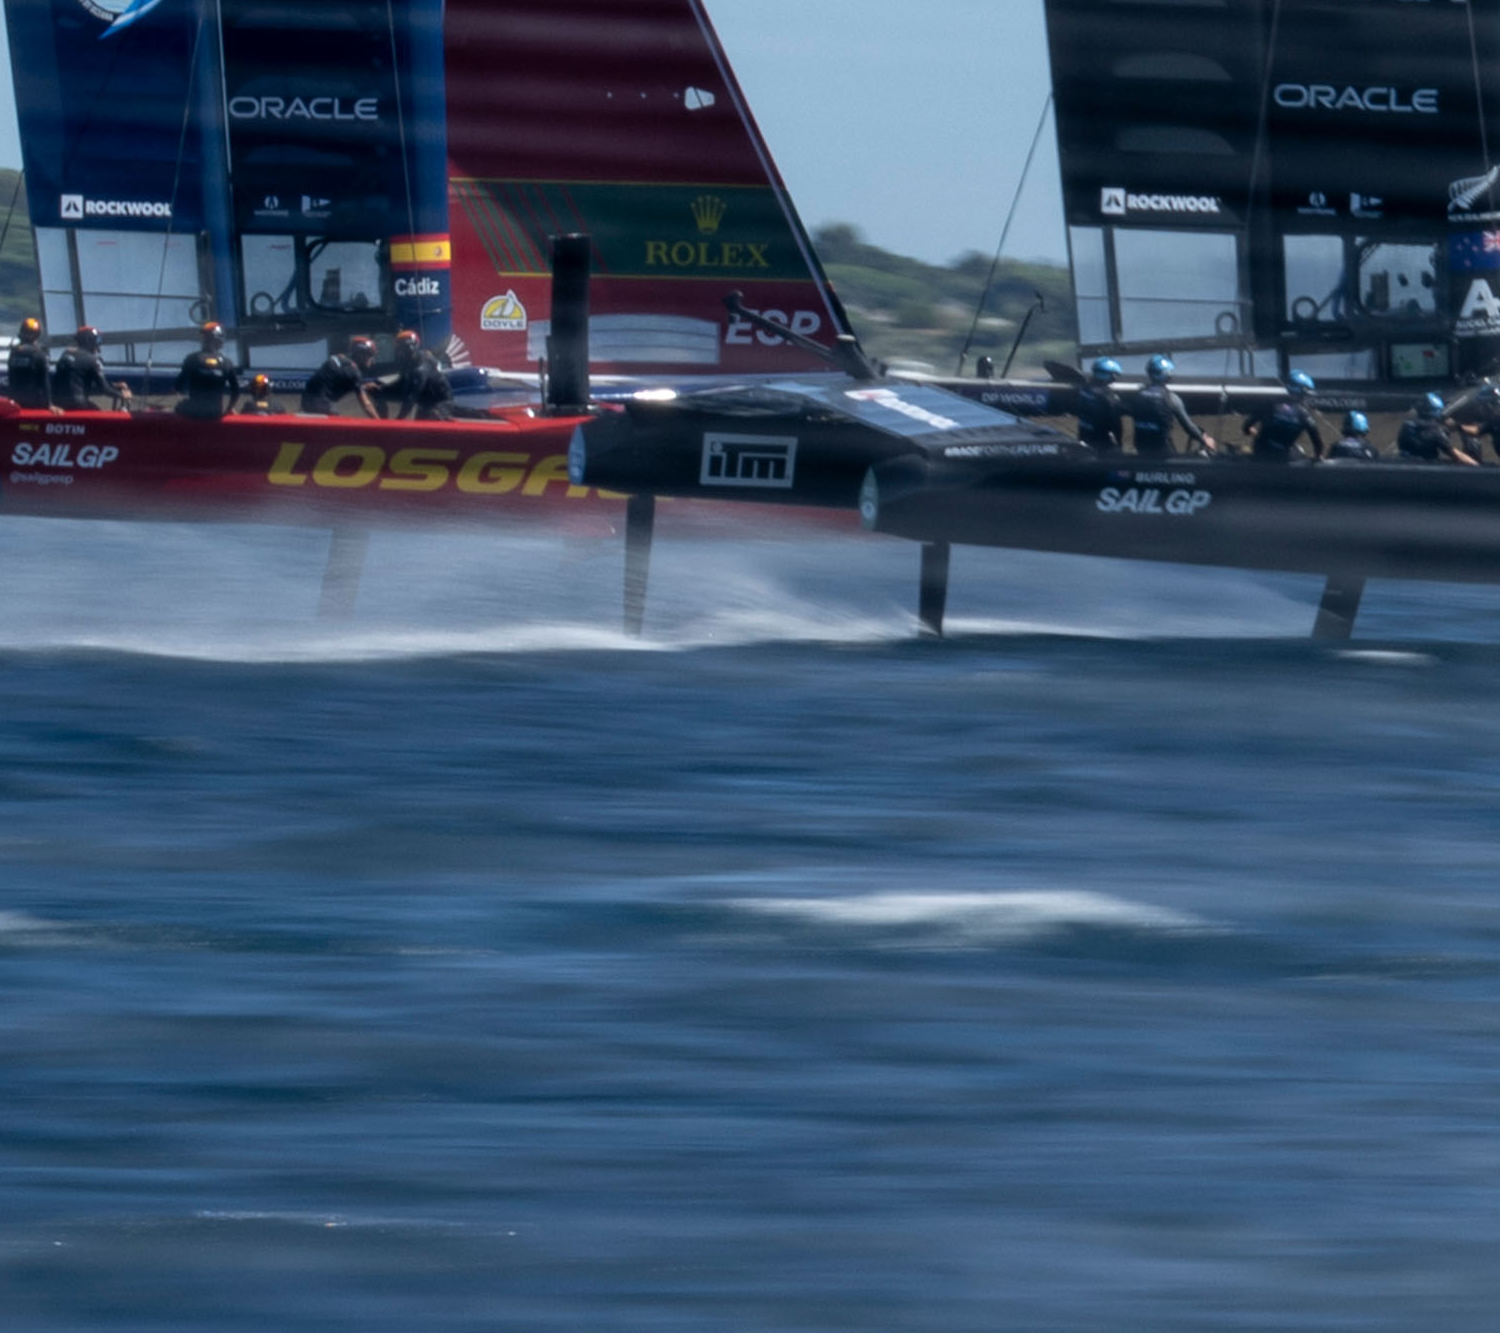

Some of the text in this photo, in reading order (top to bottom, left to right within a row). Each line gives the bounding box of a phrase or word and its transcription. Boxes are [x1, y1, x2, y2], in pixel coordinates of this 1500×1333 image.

[229, 95, 379, 121] ORACLE
[1273, 82, 1438, 113] ORACLE
[85, 199, 173, 218] ROCKWOOL
[1126, 193, 1221, 214] ROCKWOOL
[643, 240, 769, 270] ROLEX
[394, 277, 440, 296] Cádiz
[482, 318, 525, 330] DOYLE
[725, 309, 821, 347] ESP
